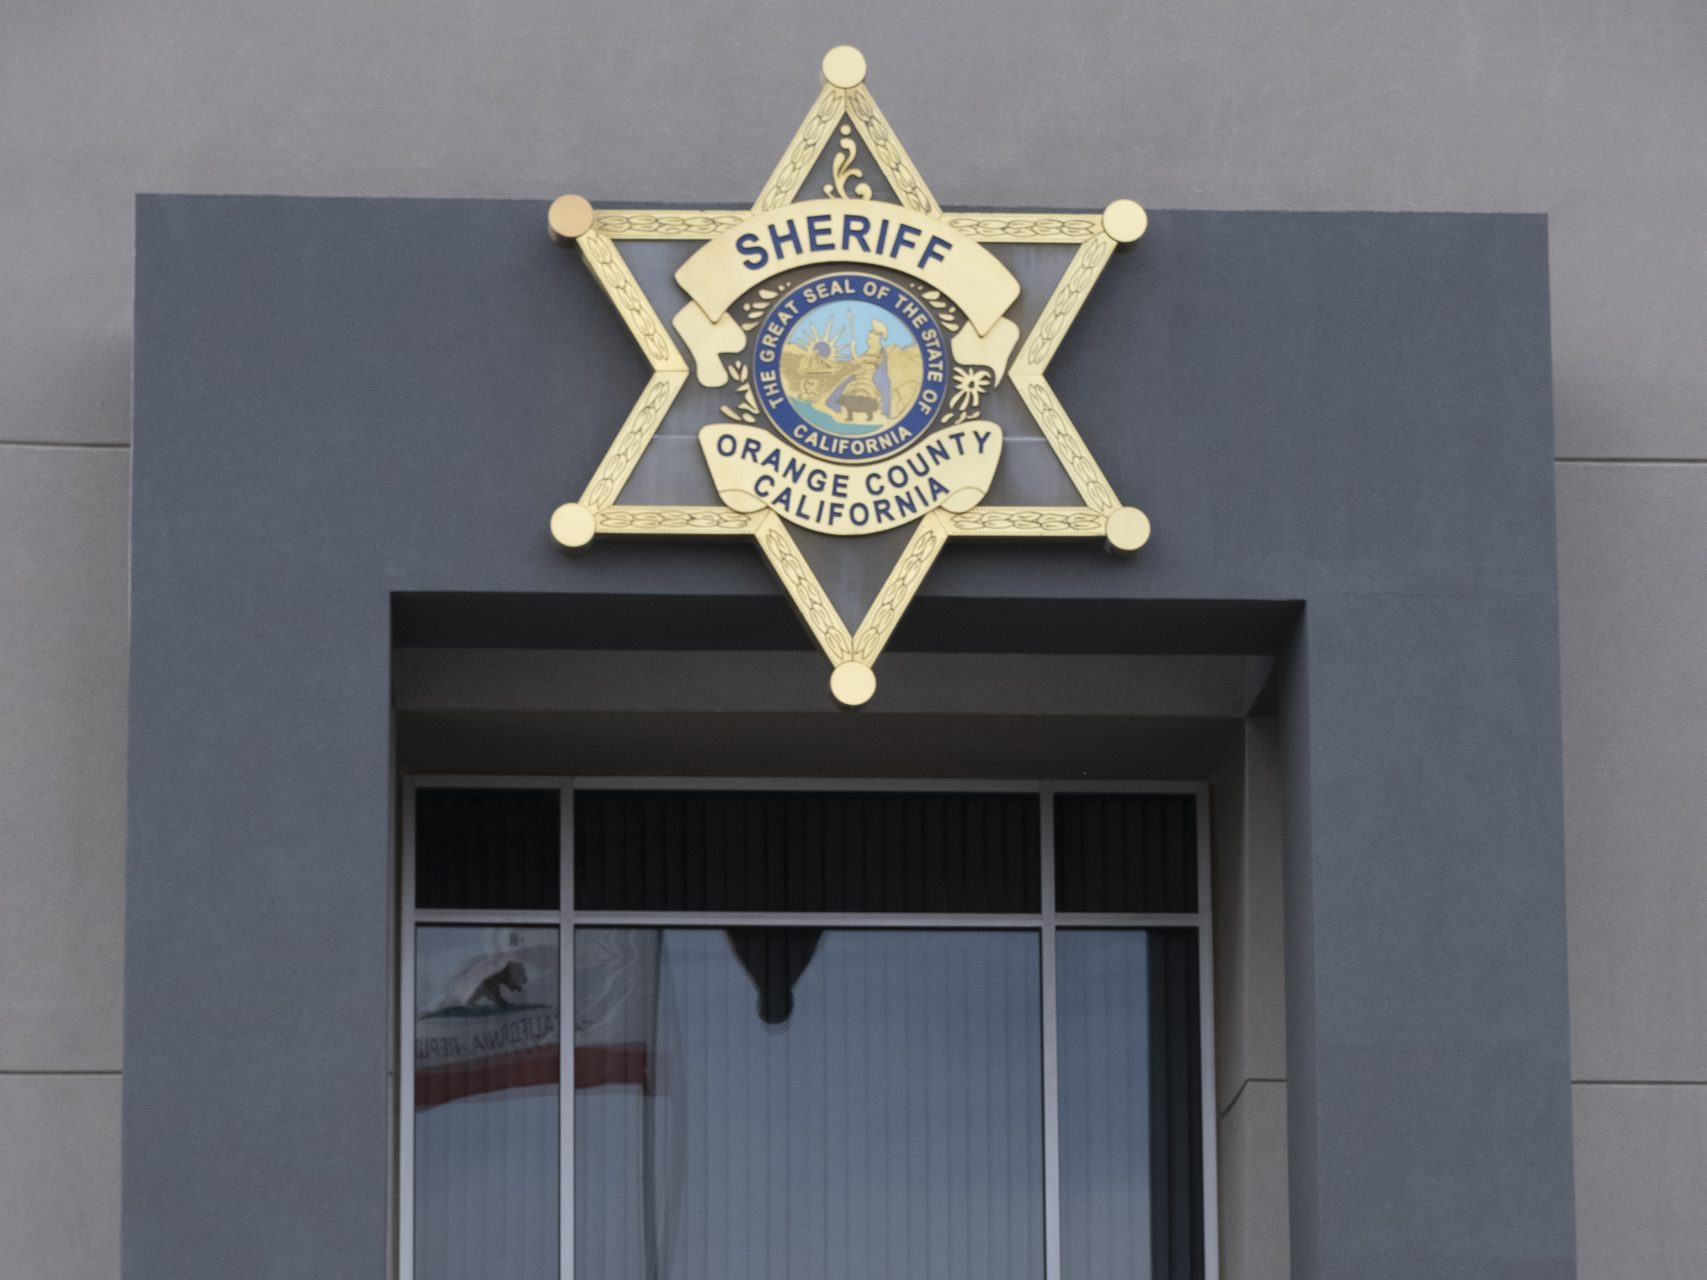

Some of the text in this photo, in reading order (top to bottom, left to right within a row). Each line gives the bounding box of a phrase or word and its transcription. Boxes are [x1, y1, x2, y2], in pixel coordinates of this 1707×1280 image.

[735, 214, 953, 271] SHERIFF
[760, 279, 944, 416] THE GREAT SEAL OF THE STATE OF
[716, 431, 991, 499] ORANGE COUNTY
[792, 423, 913, 456] CALIFORNIA
[753, 474, 951, 528] CALIFORNIA
